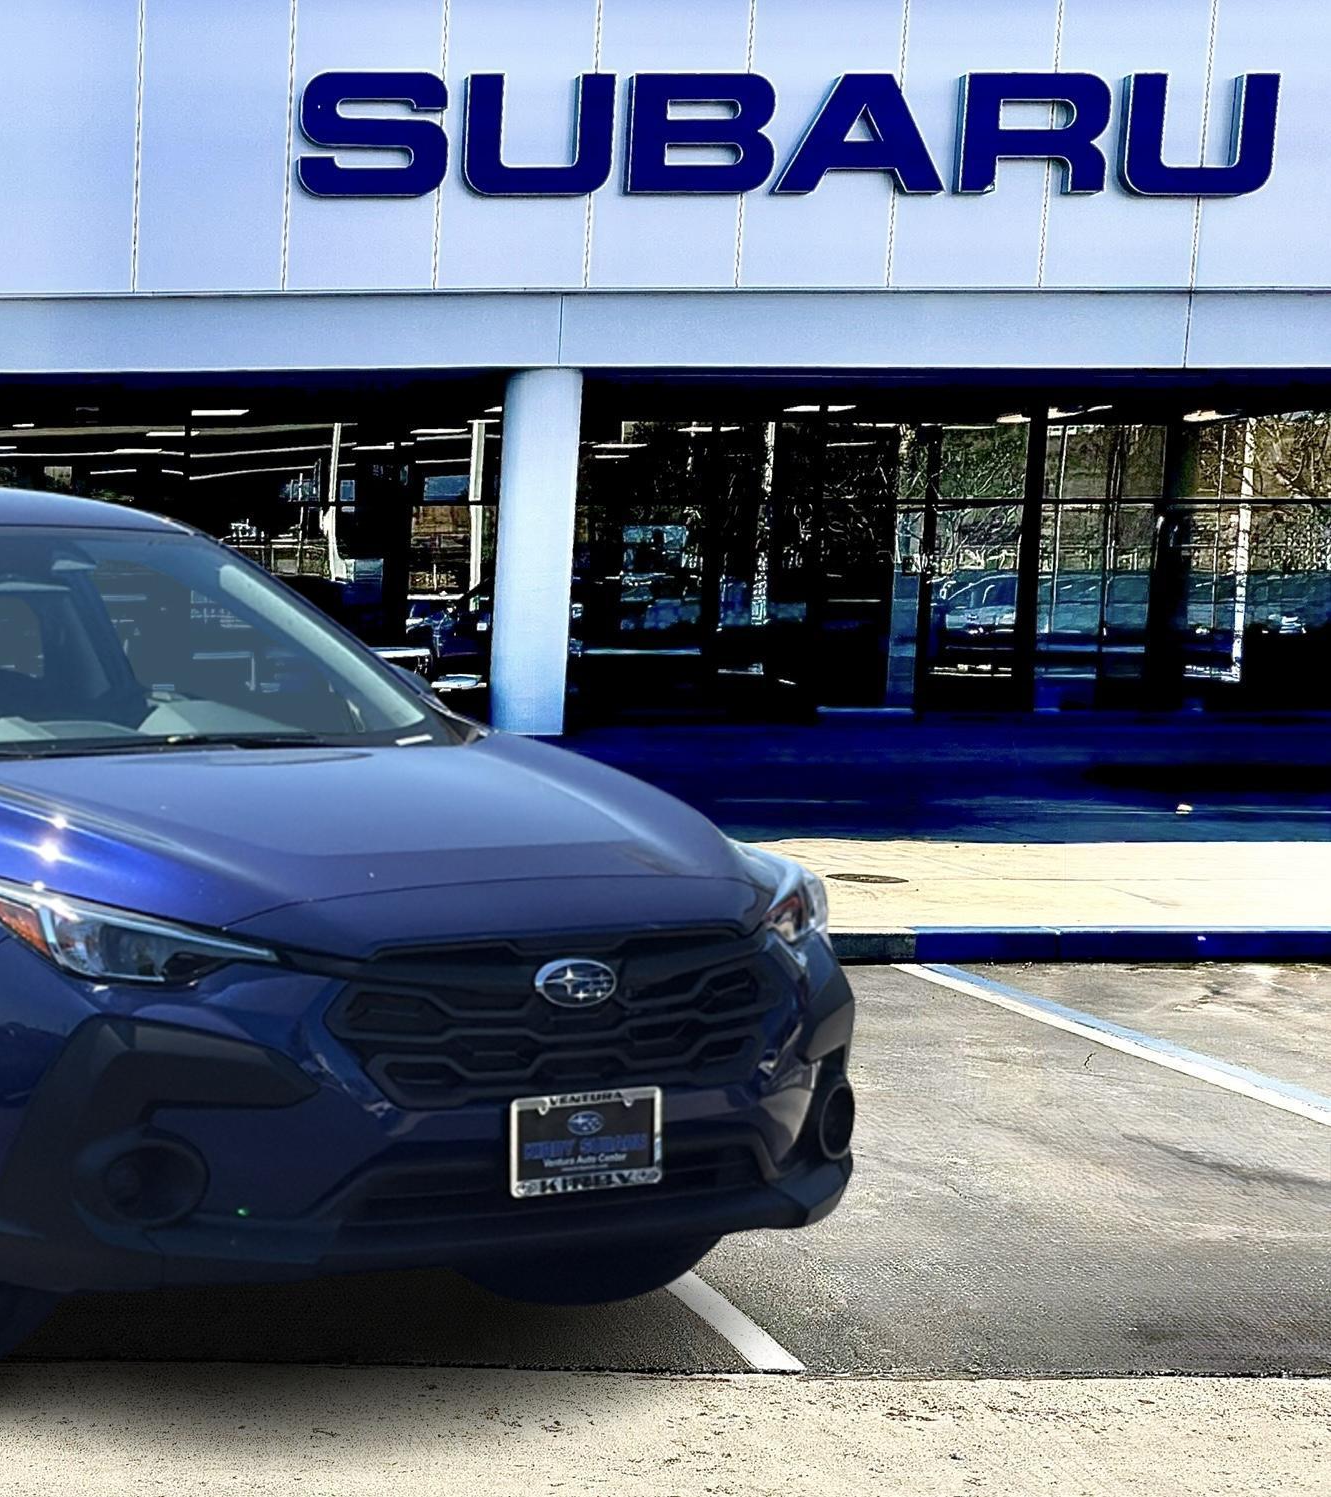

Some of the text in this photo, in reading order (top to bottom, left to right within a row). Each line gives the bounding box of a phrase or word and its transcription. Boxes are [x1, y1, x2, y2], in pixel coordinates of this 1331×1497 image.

[296, 71, 1281, 199] SUBARU
[549, 1091, 624, 1106] VENTURA
[543, 1156, 575, 1168] Ventura
[576, 1154, 597, 1165] Auto
[598, 1152, 627, 1163] Center
[540, 1172, 633, 1193] KIRBY
